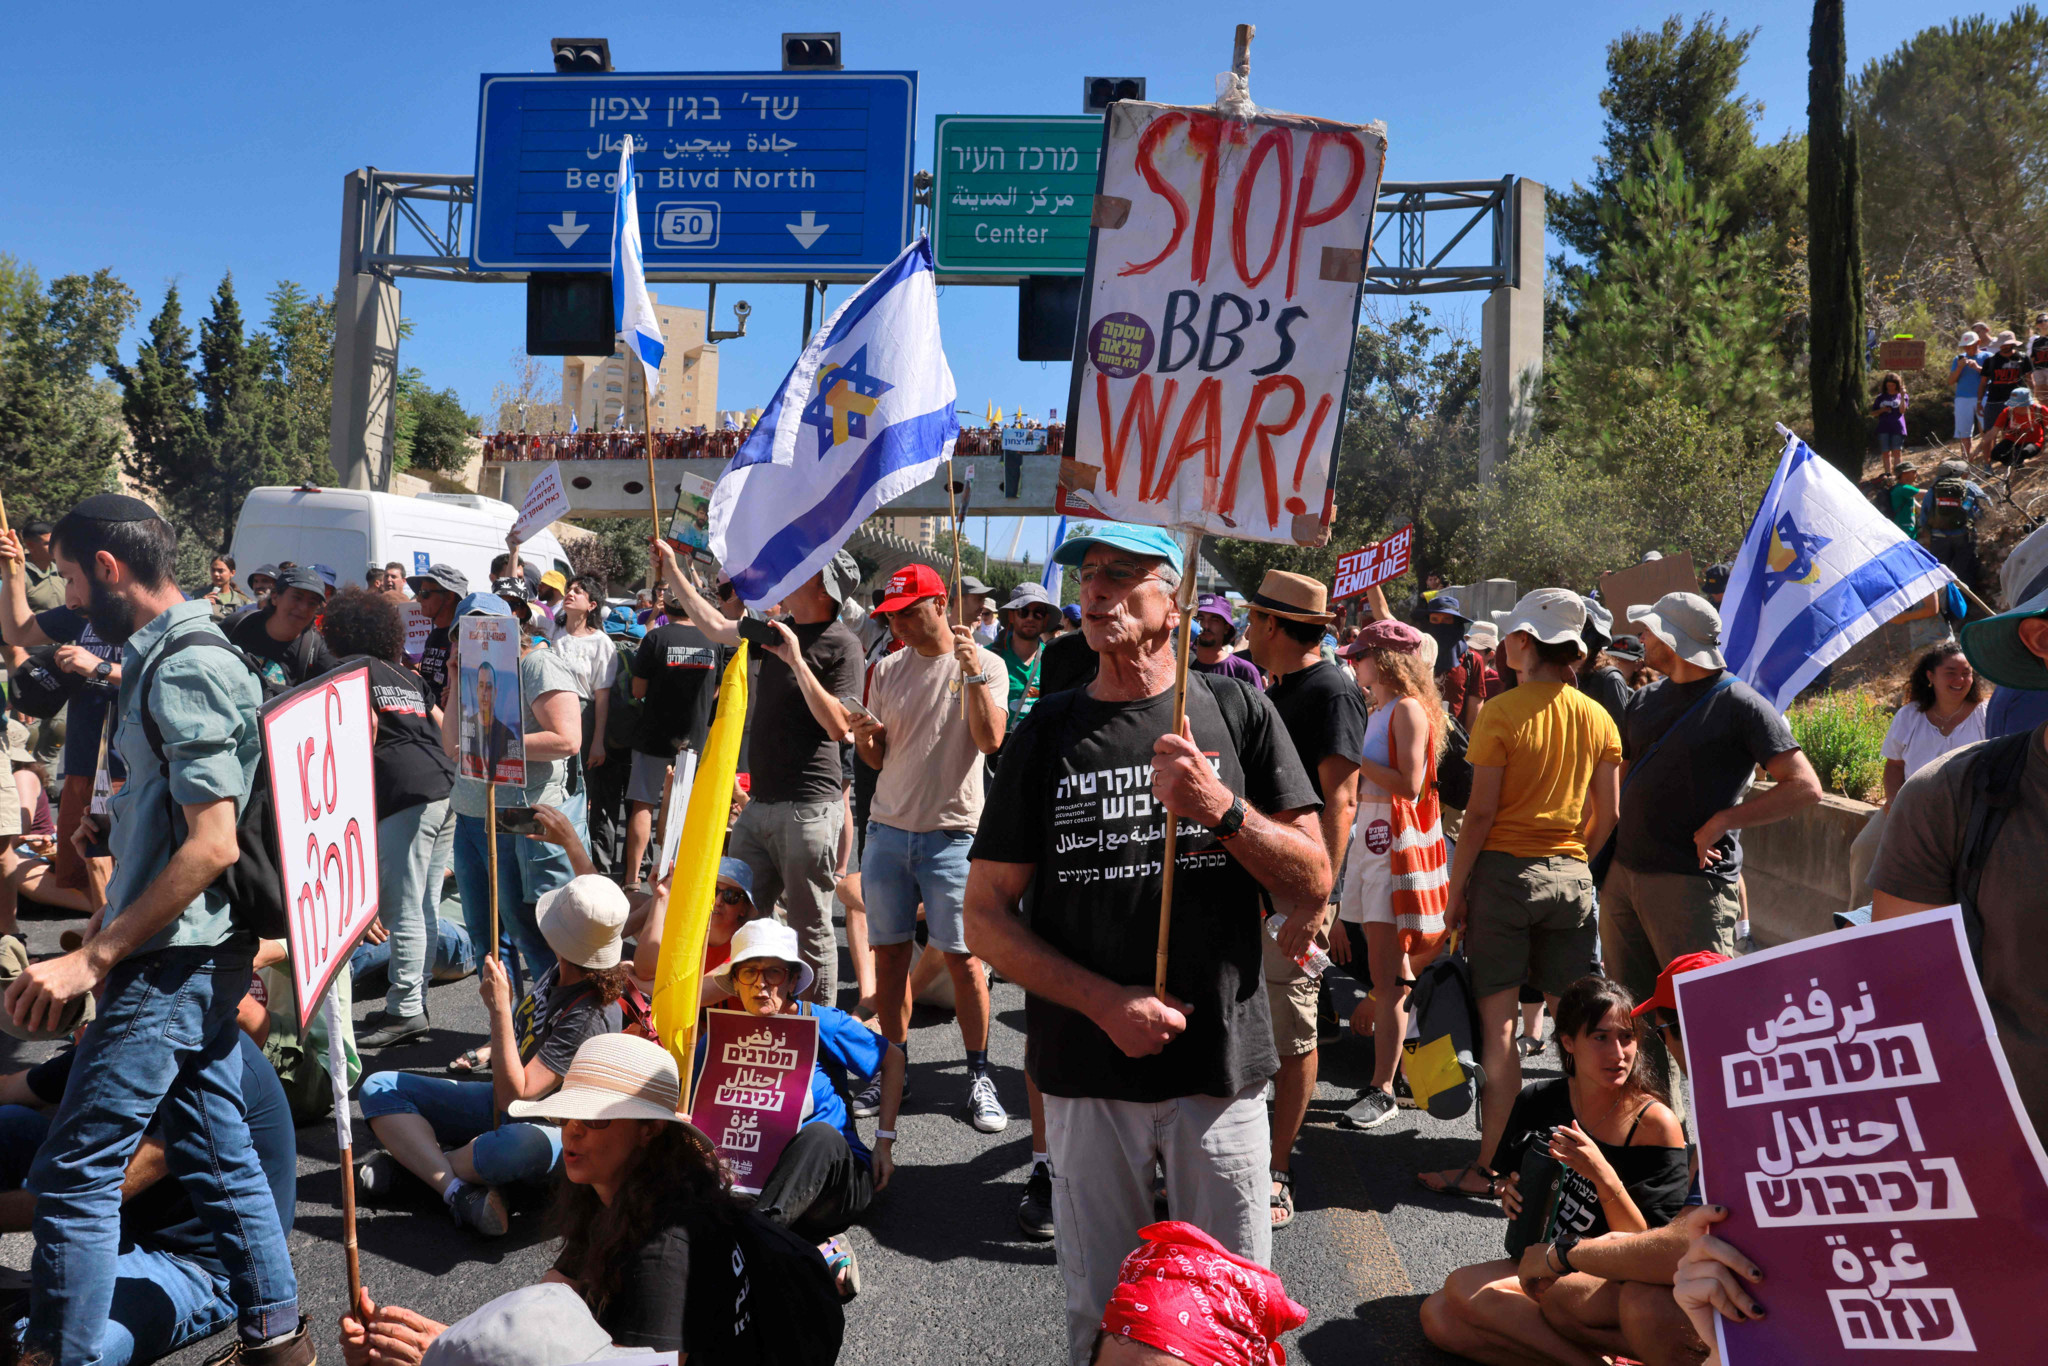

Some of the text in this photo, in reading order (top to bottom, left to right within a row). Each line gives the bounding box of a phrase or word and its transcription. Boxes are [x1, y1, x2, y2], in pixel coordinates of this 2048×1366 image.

[589, 96, 651, 128] צפון
[667, 96, 722, 127] בגין
[746, 132, 798, 158] جادة
[950, 146, 1006, 174] העיר
[1018, 146, 1079, 172] מרכז
[566, 166, 816, 194] Begn Blvd North
[951, 184, 1076, 215] مركز المدينة
[1116, 111, 1366, 302] STOP
[672, 215, 703, 236] 50
[974, 222, 1050, 244] Center
[1102, 320, 1146, 342] עסקה
[1096, 352, 1140, 370] ולא פחות
[1099, 336, 1143, 359] מלאה
[1096, 371, 1335, 532] WAR!
[1337, 528, 1410, 577] STOP TEH
[1332, 549, 1407, 599] GENOCIDE
[296, 683, 342, 824] לא
[1056, 764, 1153, 799] וקרטיה
[1073, 816, 1097, 824] COEXIST
[1105, 832, 1129, 850] مع
[1104, 860, 1162, 880] לכיבוש
[1174, 853, 1227, 870] מסתכלי
[1746, 977, 1876, 1055] نرفض
[737, 1026, 786, 1050] نرفض
[727, 1046, 793, 1067] מסרבים
[1731, 1034, 1922, 1099] מסרבים
[725, 1067, 784, 1090] احتلال
[720, 1088, 782, 1109] לכיבוש
[730, 1110, 759, 1133] غزة
[726, 1133, 758, 1149] עזה
[1756, 1096, 1927, 1176] احتلال
[1756, 1166, 1950, 1218] לכיבוש
[1824, 1228, 1929, 1298] غزة
[1839, 1297, 1955, 1342] עזה
